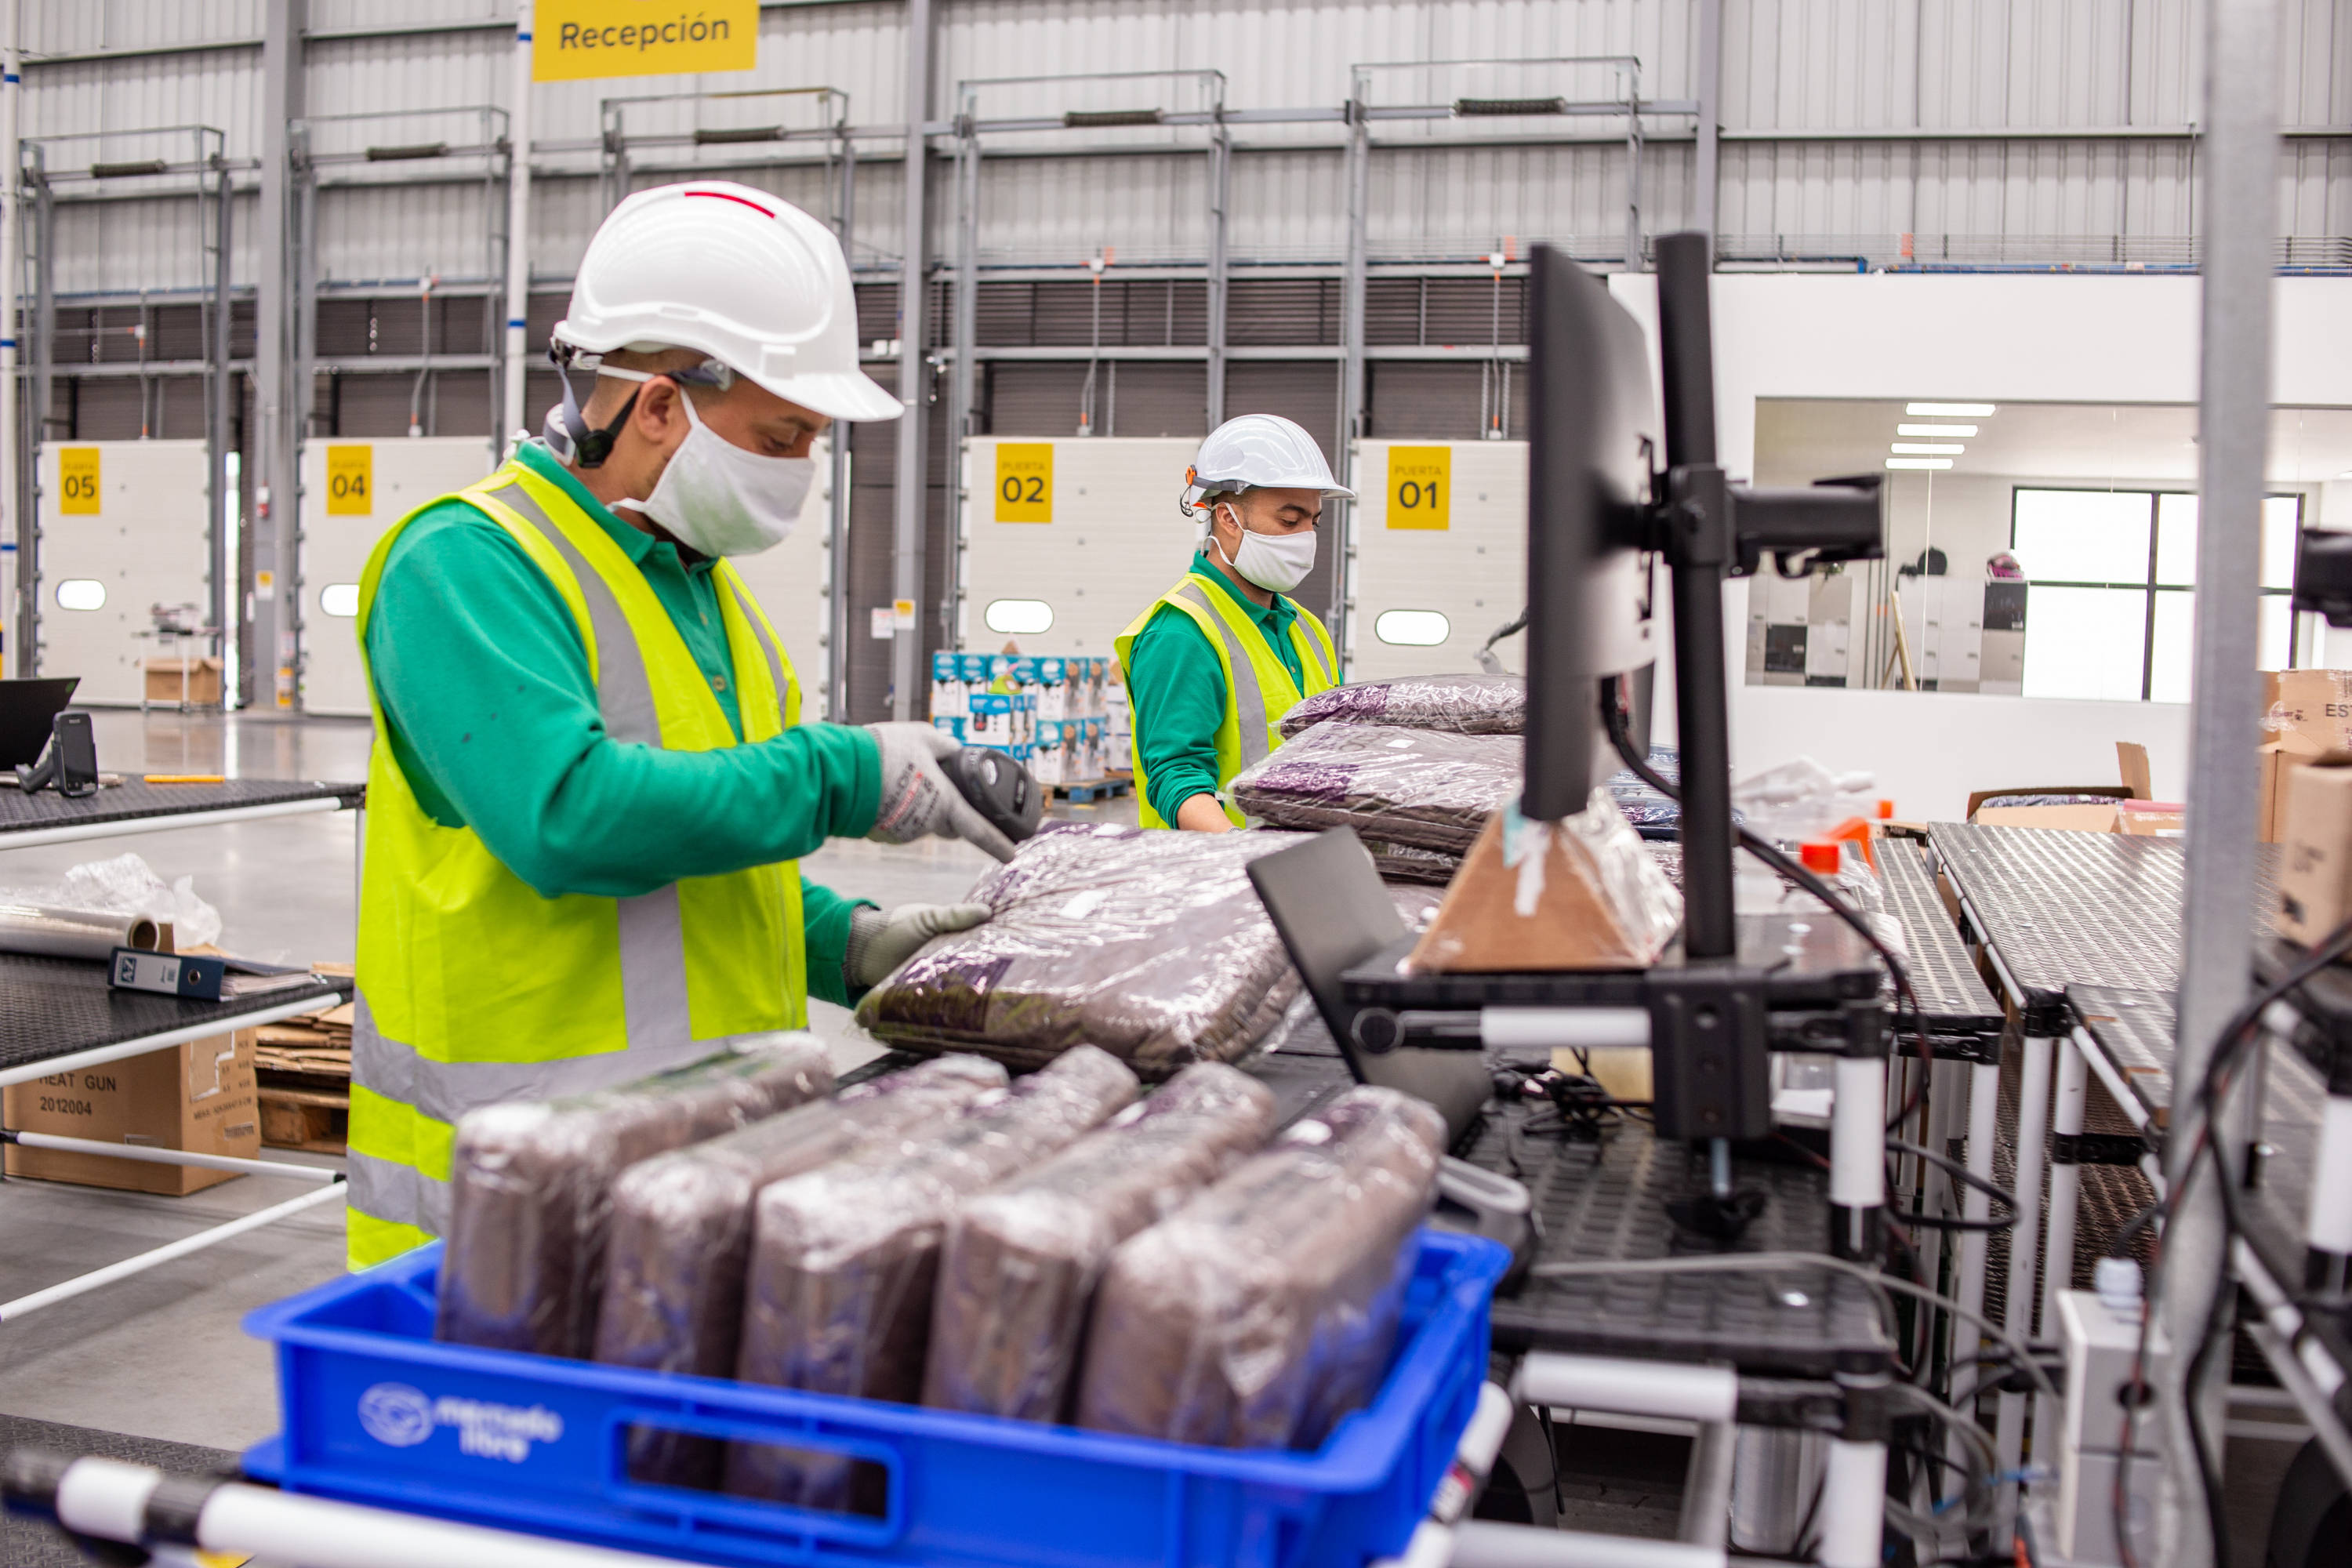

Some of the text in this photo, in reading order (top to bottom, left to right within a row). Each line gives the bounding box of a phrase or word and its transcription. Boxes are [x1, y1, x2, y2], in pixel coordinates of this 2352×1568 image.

[560, 13, 730, 51] Recepción
[1394, 465, 1443, 476] PUERTA
[65, 474, 95, 499] 05
[332, 474, 365, 498] 04
[1002, 476, 1044, 503] 02
[1399, 481, 1436, 509] 01
[2325, 703, 2352, 717] ES
[85, 1075, 116, 1091] GUN
[40, 1096, 93, 1116] 2012004
